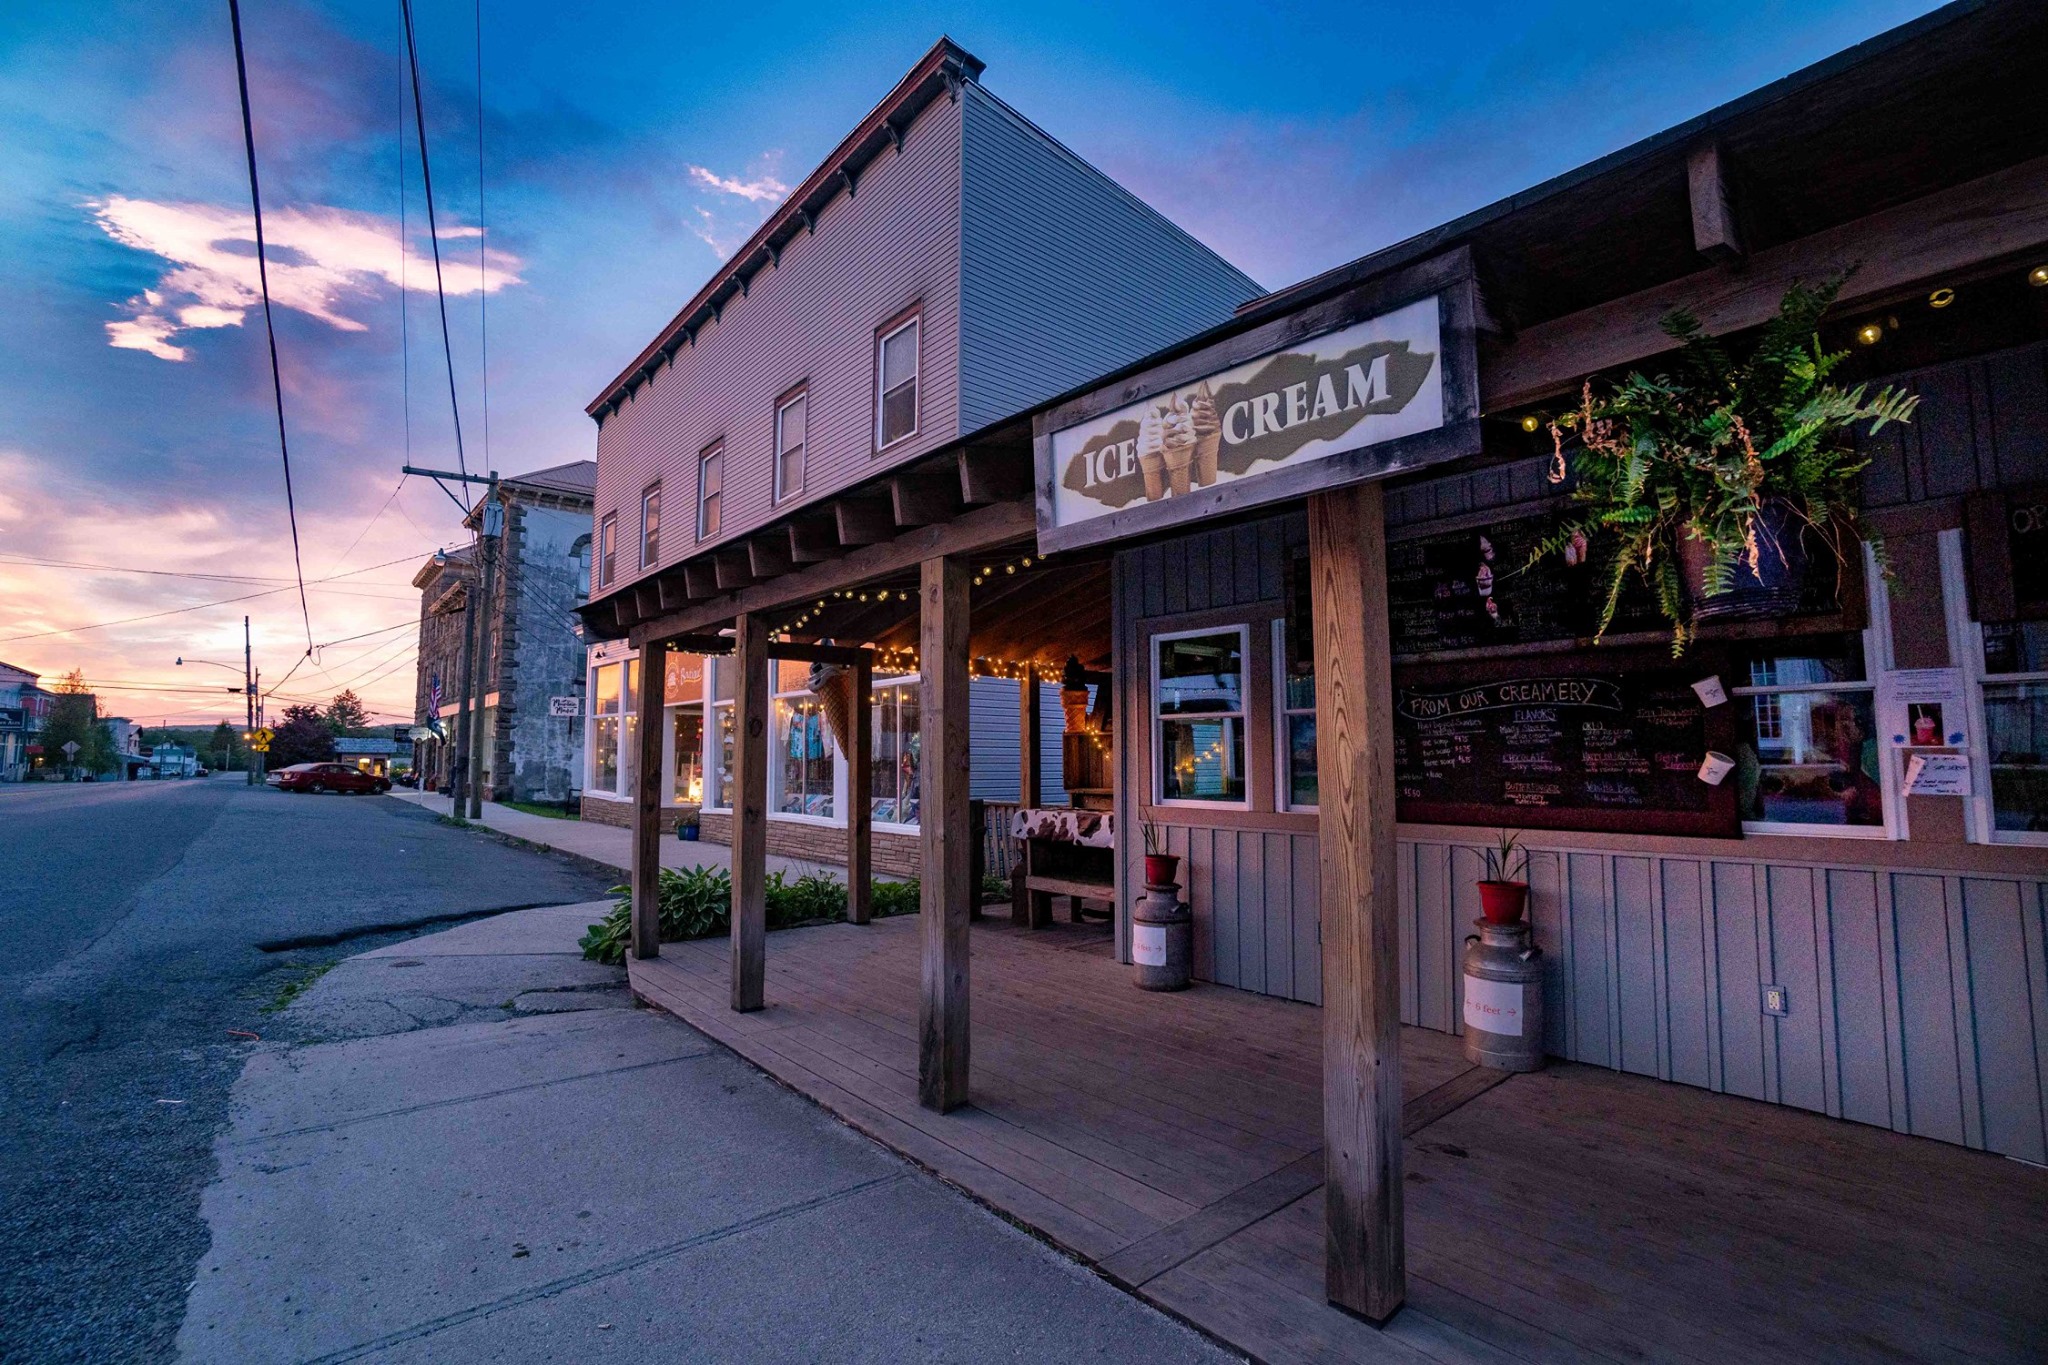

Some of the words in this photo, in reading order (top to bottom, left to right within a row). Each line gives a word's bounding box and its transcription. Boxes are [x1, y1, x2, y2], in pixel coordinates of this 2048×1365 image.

[1082, 438, 1136, 489] ICE
[1222, 353, 1392, 445] CREAM
[1410, 697, 1450, 716] FROM
[1459, 690, 1489, 710] OUR
[1499, 682, 1598, 704] CREAMERY
[1475, 1002, 1481, 1012] 6
[1483, 1004, 1501, 1016] feet
